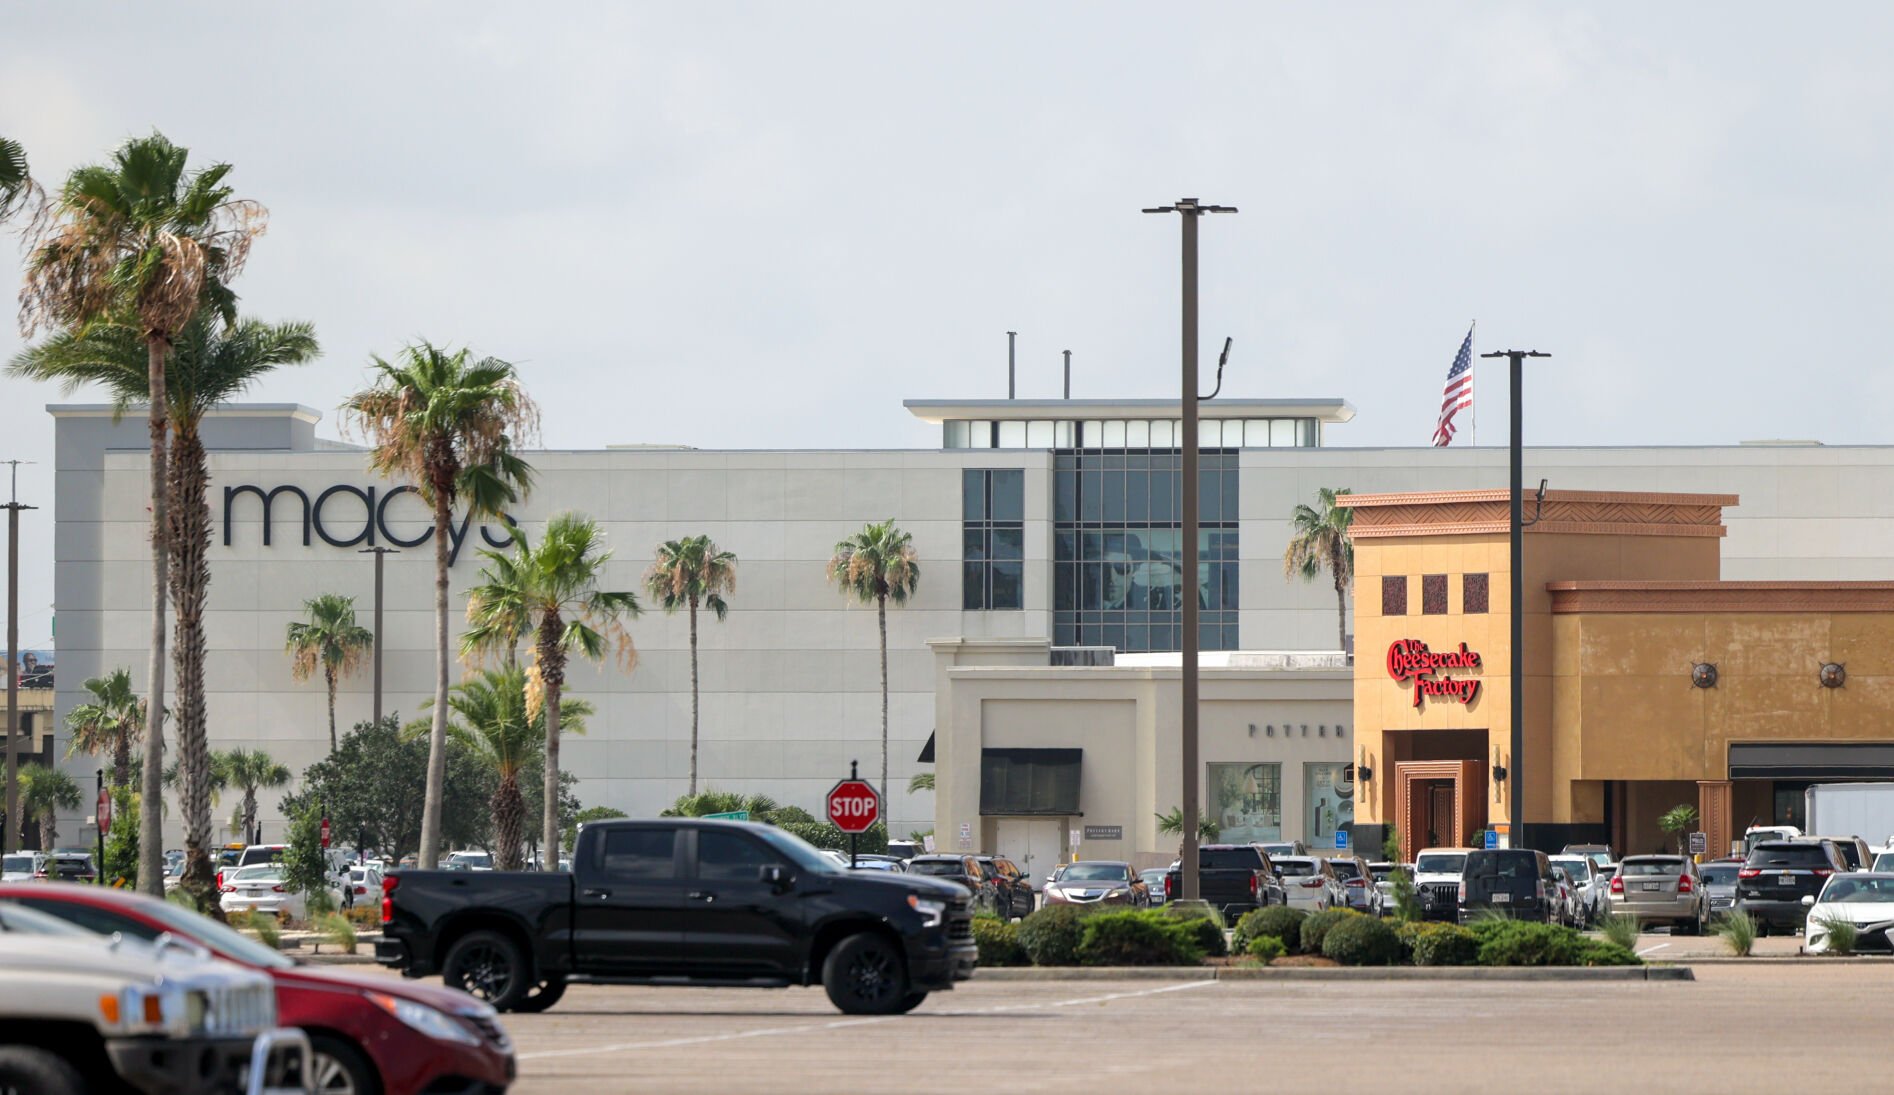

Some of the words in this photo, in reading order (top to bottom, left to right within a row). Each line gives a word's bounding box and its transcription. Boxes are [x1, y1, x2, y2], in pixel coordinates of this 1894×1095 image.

[1408, 640, 1425, 652] The
[1387, 640, 1479, 681] Cheesecake
[1405, 667, 1478, 707] Factory
[1248, 724, 1354, 738] POTTER
[831, 797, 875, 816] STOP
